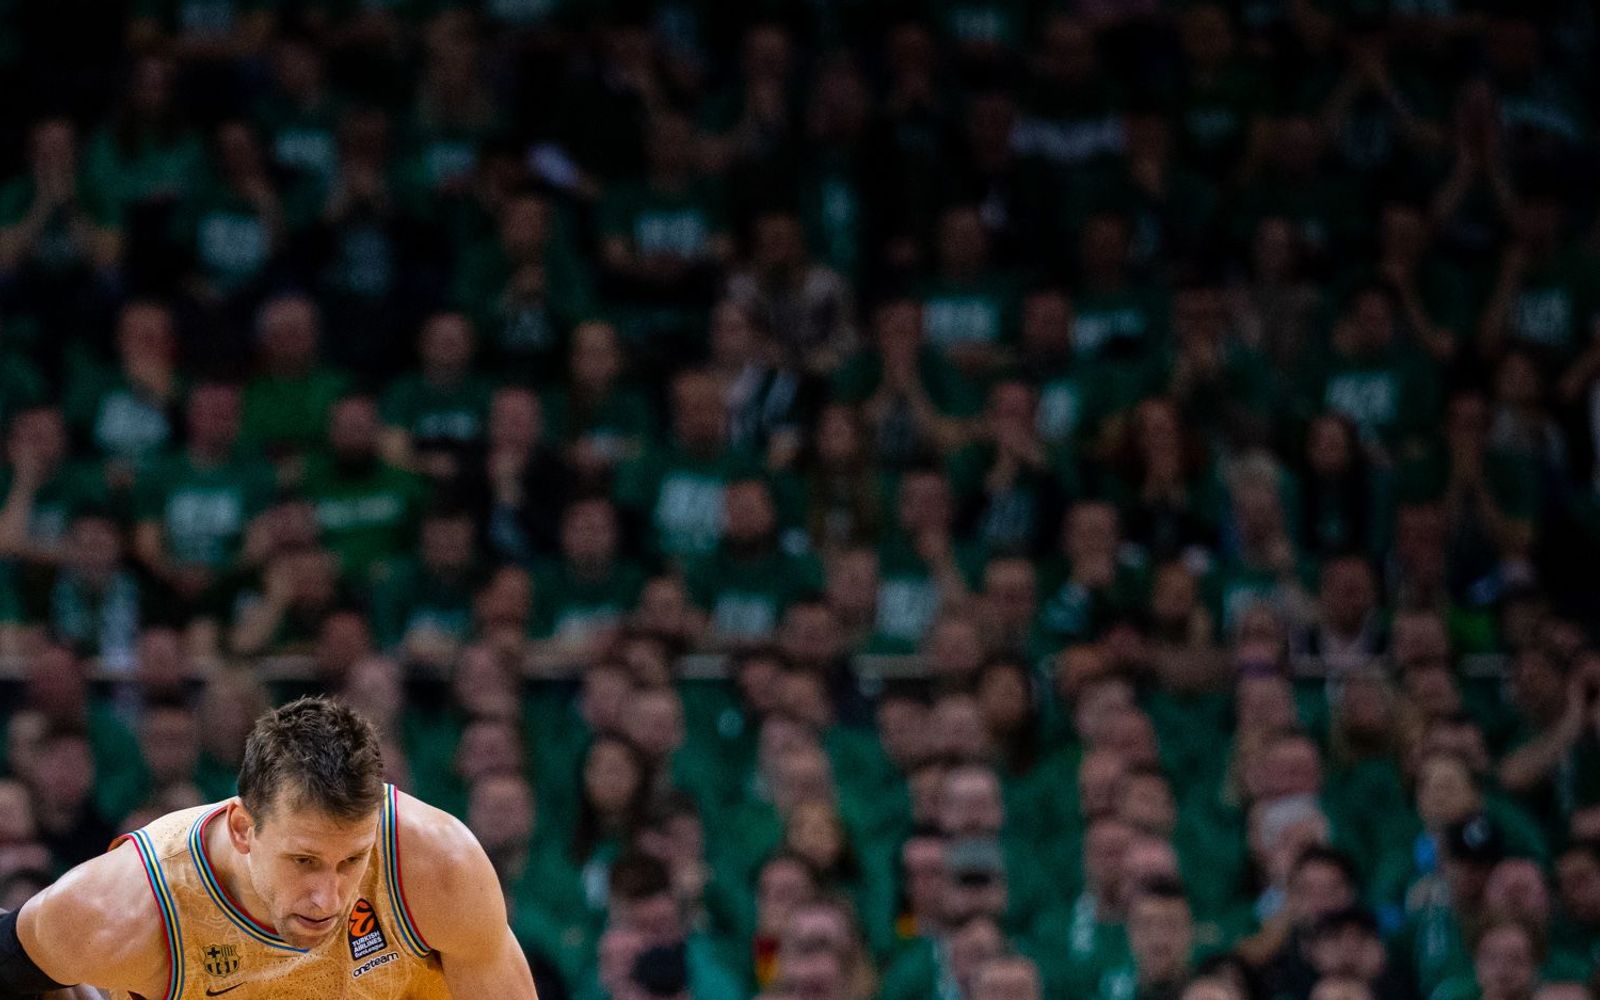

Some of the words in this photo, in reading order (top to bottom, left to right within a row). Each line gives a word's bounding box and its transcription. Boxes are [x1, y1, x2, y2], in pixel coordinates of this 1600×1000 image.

[352, 931, 381, 947] TURKISH
[353, 938, 383, 954] AIRLINES
[353, 952, 399, 977] oneteam
